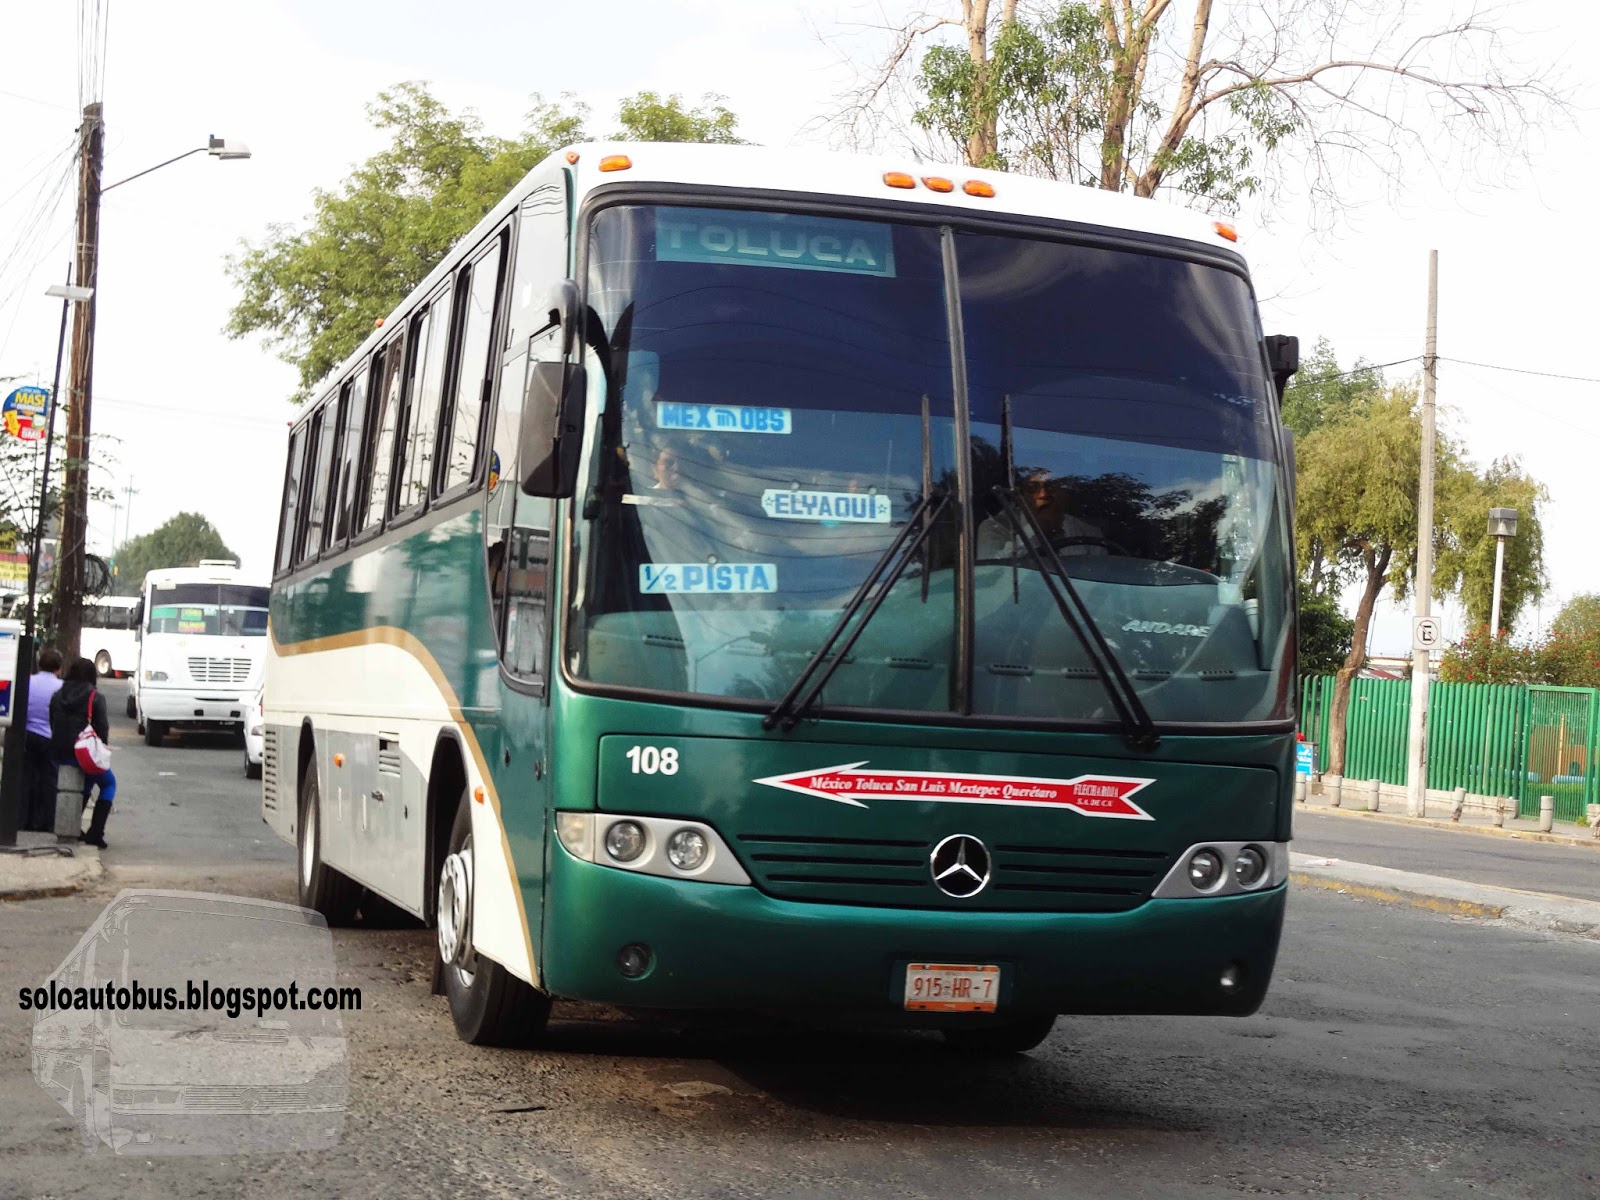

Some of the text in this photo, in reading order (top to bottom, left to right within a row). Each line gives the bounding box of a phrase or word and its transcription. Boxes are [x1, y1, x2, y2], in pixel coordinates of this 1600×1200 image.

[664, 220, 877, 266] TOLUCA
[662, 405, 785, 431] MEX OBS
[774, 493, 877, 519] ELYAQUI
[682, 566, 770, 591] PISTA
[626, 745, 679, 776] 108
[809, 776, 853, 790] México
[855, 778, 893, 791] Toluca
[895, 779, 918, 792] San
[920, 780, 946, 793] Luis
[1002, 784, 1058, 800] Querétaro
[913, 977, 993, 998] 915-HR-7
